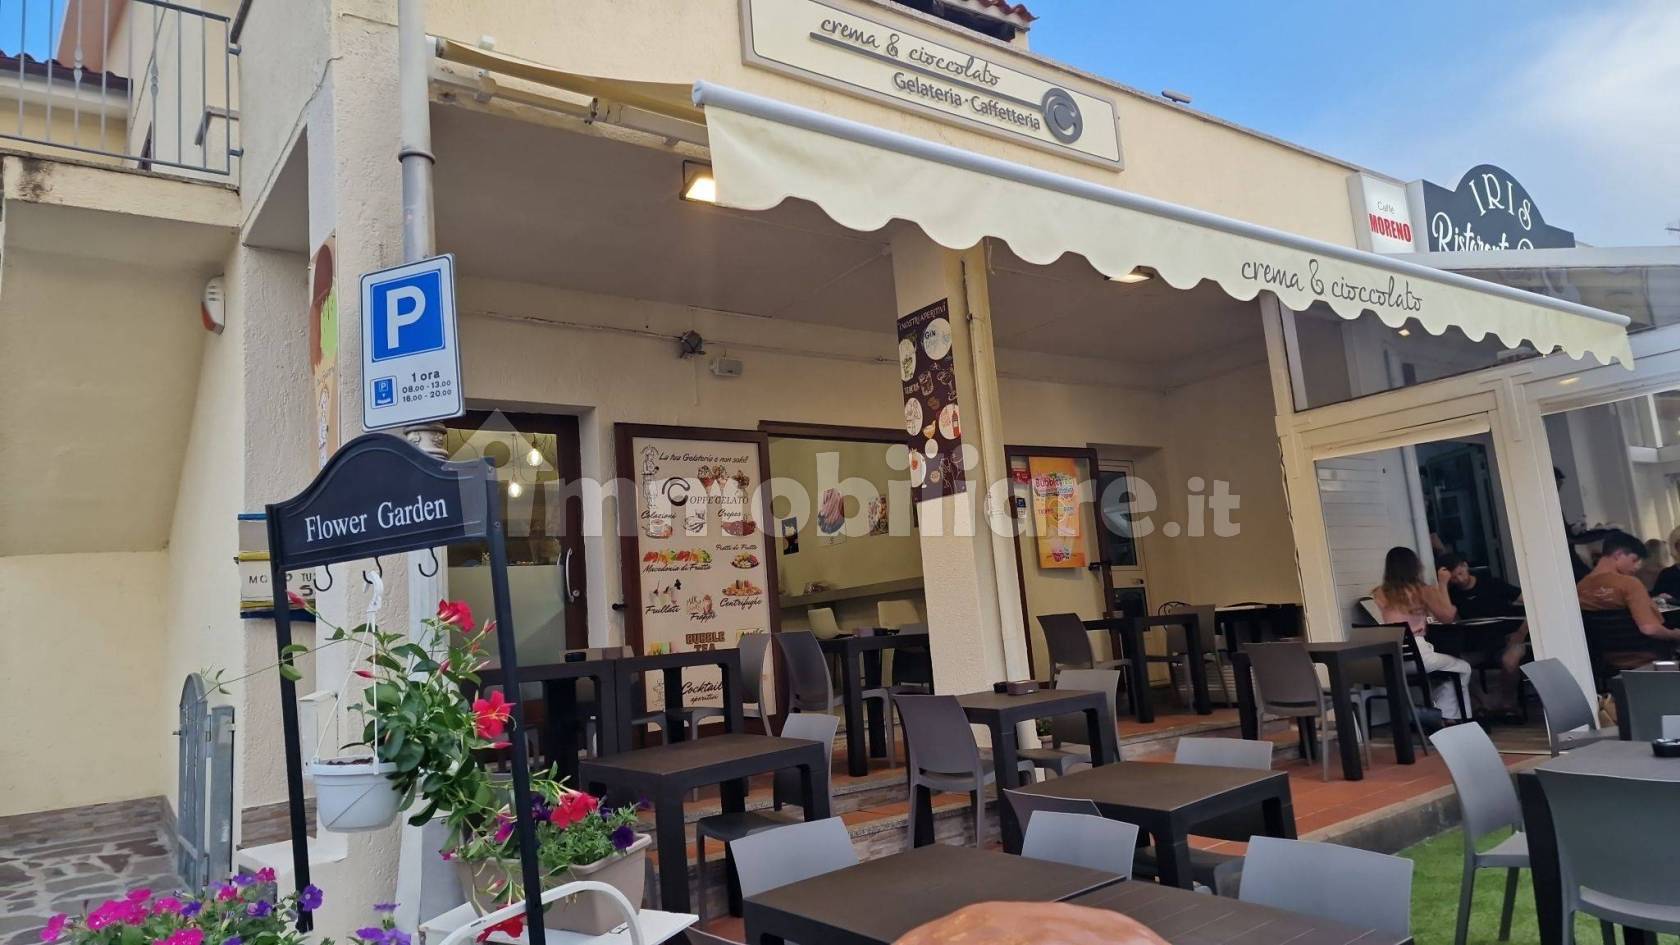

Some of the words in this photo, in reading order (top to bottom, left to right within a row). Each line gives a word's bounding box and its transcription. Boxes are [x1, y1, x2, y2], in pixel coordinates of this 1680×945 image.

[820, 16, 880, 49] crema
[886, 33, 900, 57] &
[908, 46, 1000, 87] cioccolato
[893, 71, 963, 107] Gelateria
[971, 95, 1041, 131] Caffetteria
[1469, 173, 1532, 231] IRIS
[1368, 212, 1412, 243] MORENO
[1241, 261, 1304, 292] crema
[1309, 258, 1325, 296] &
[1331, 275, 1422, 312] cioccolato
[386, 285, 426, 350] P
[402, 384, 425, 394] 08.00
[431, 380, 451, 389] 13.00
[411, 372, 417, 382] 1
[420, 370, 440, 381] ora
[430, 389, 452, 398] 20.00
[659, 452, 669, 461] La
[682, 453, 713, 463] Gelateria
[304, 513, 368, 543] Flower
[377, 495, 448, 529] Garden
[689, 563, 712, 571] Frutta
[685, 631, 726, 645] BUBBLE
[681, 681, 723, 695] Cocktail
